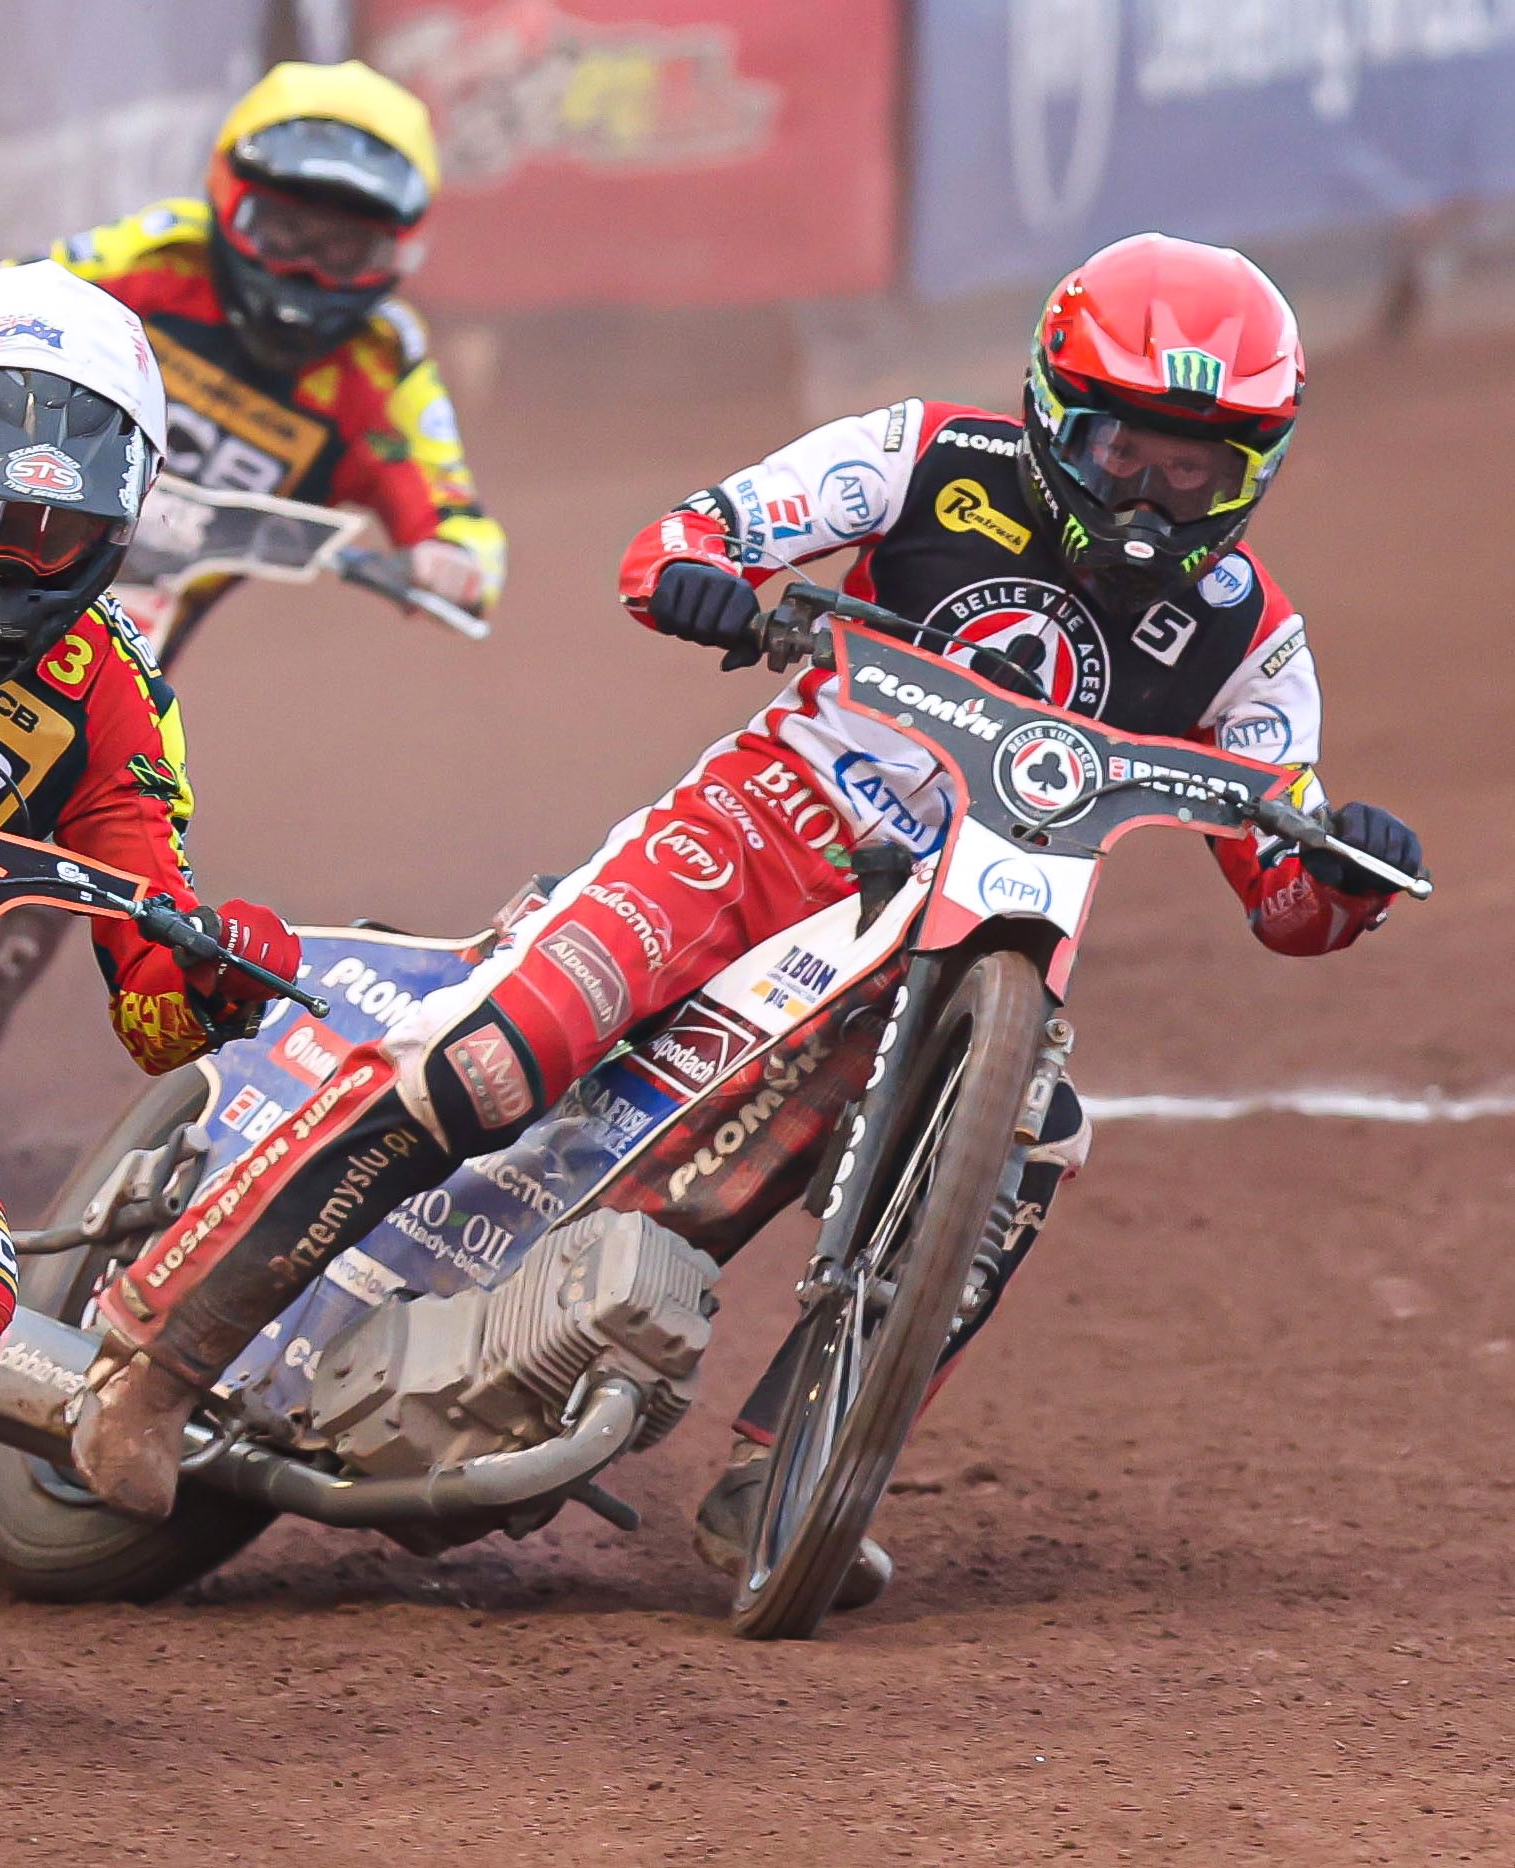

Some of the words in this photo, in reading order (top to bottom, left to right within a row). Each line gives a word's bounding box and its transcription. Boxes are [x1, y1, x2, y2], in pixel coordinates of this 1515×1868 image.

[10, 461, 77, 486] STS
[943, 486, 1024, 546] Rentruck
[951, 587, 1027, 619] BELLE
[1042, 592, 1084, 632] VUE
[1078, 643, 1101, 704] ACES
[1136, 602, 1193, 653] 5
[46, 634, 94, 685] 3
[1007, 727, 1044, 753] BELLE
[1049, 728, 1075, 746] VUE
[1225, 718, 1279, 748] ATPI
[752, 761, 842, 849] BIO
[853, 775, 928, 843] ATPI
[667, 832, 719, 877] ATPI
[989, 876, 1043, 905] ATPI
[584, 883, 664, 972] automax
[548, 938, 614, 1024] Alpodach
[468, 1037, 525, 1117] AMD
[649, 1032, 716, 1083] Alpodach
[144, 1134, 290, 1289] Henderson
